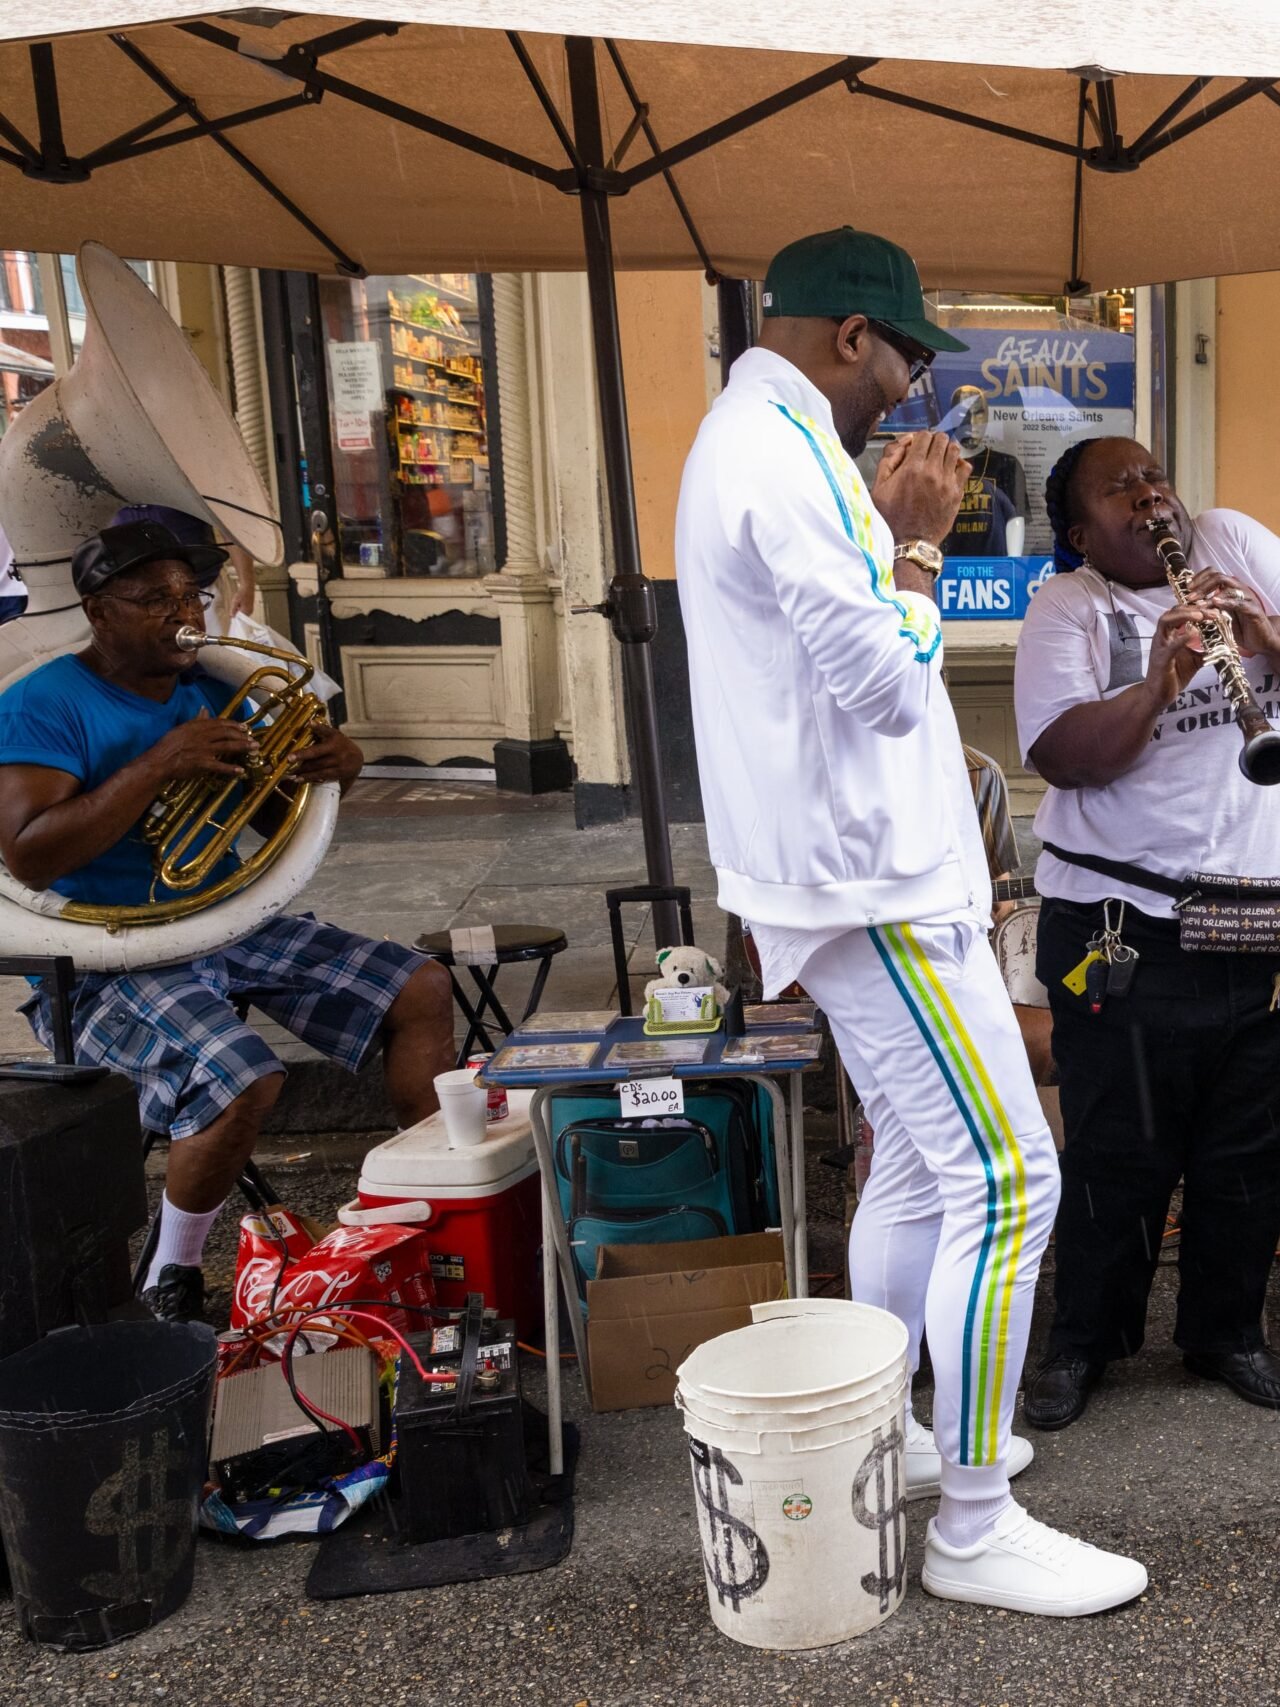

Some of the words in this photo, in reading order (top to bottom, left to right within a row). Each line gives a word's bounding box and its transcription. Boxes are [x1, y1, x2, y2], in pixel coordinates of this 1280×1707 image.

[997, 336, 1089, 366] GEAUX
[981, 358, 1108, 400] SAINTS
[993, 410, 1018, 421] New
[1021, 411, 1065, 422] Orleans
[1068, 411, 1104, 423] Saints
[1041, 424, 1073, 432] Schedule
[957, 566, 975, 577] FOR
[977, 566, 994, 577] THE
[941, 579, 1011, 610] FANS
[1200, 874, 1239, 886] ORLEANS
[1253, 879, 1269, 887] NEW
[1221, 907, 1239, 915] NEW
[1241, 908, 1275, 916] ORLEANS
[1181, 917, 1200, 926] NEW
[1202, 918, 1240, 928] ORLEANS
[1254, 921, 1270, 929] NEW
[1221, 933, 1238, 941] NEW
[1240, 933, 1275, 942] ORLEANS
[1181, 943, 1199, 951] NEW
[1201, 945, 1237, 953] ORLEANS
[631, 1091, 678, 1107] $20.00
